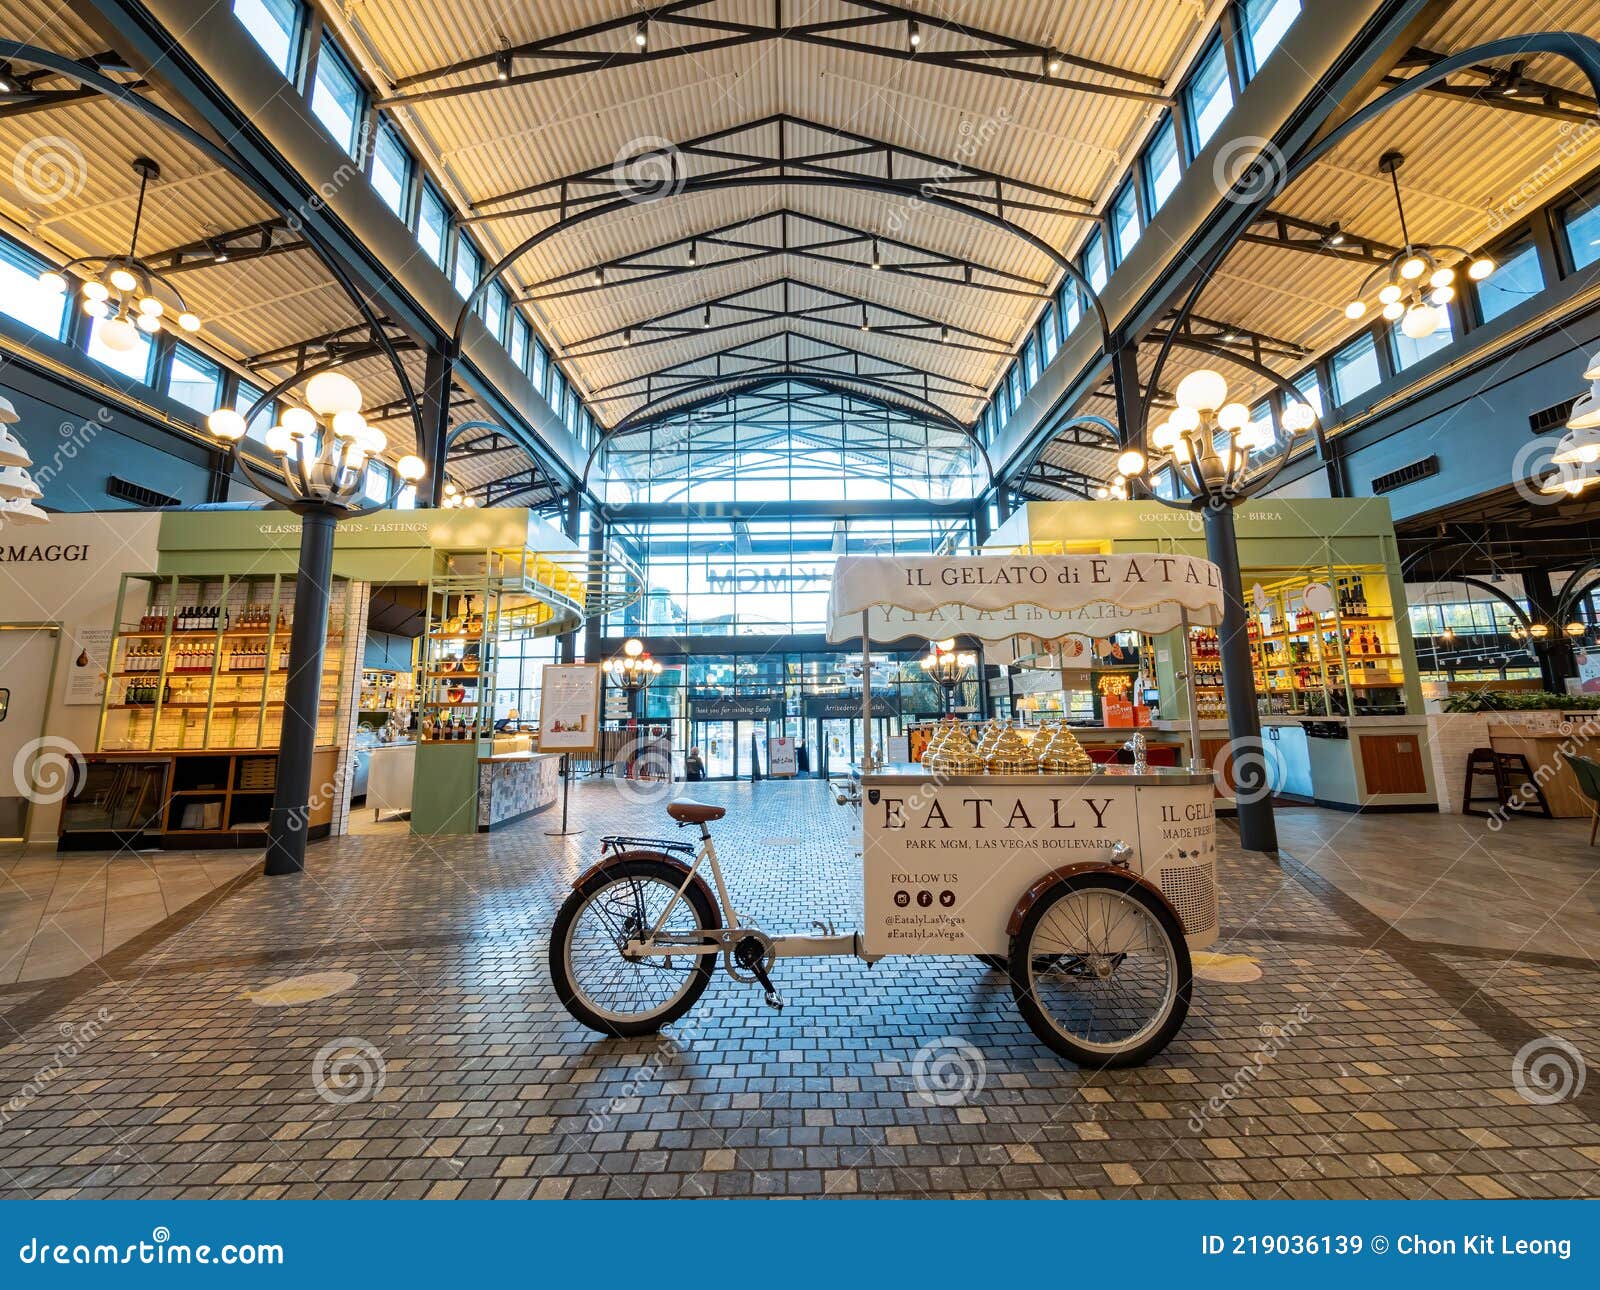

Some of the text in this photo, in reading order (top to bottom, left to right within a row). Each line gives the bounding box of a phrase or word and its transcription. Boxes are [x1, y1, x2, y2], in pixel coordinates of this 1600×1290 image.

[1249, 511, 1282, 520] BIRRA
[259, 522, 428, 534] CLASSE ENTS TASTINGS
[906, 568, 931, 586] IL
[941, 566, 1048, 586] GELATO
[1057, 566, 1080, 584] di
[882, 798, 1114, 829] EATALY
[1161, 805, 1181, 822] IL
[1163, 828, 1192, 839] MADE
[906, 839, 936, 849] PARK
[940, 839, 972, 850] MGM,
[976, 839, 997, 849] LAS
[999, 839, 1039, 849] VEGAS
[891, 873, 959, 883] FOLLOW US
[885, 914, 966, 927] @EatalyLasVegas
[887, 928, 965, 941] #EatalyLasVegas
